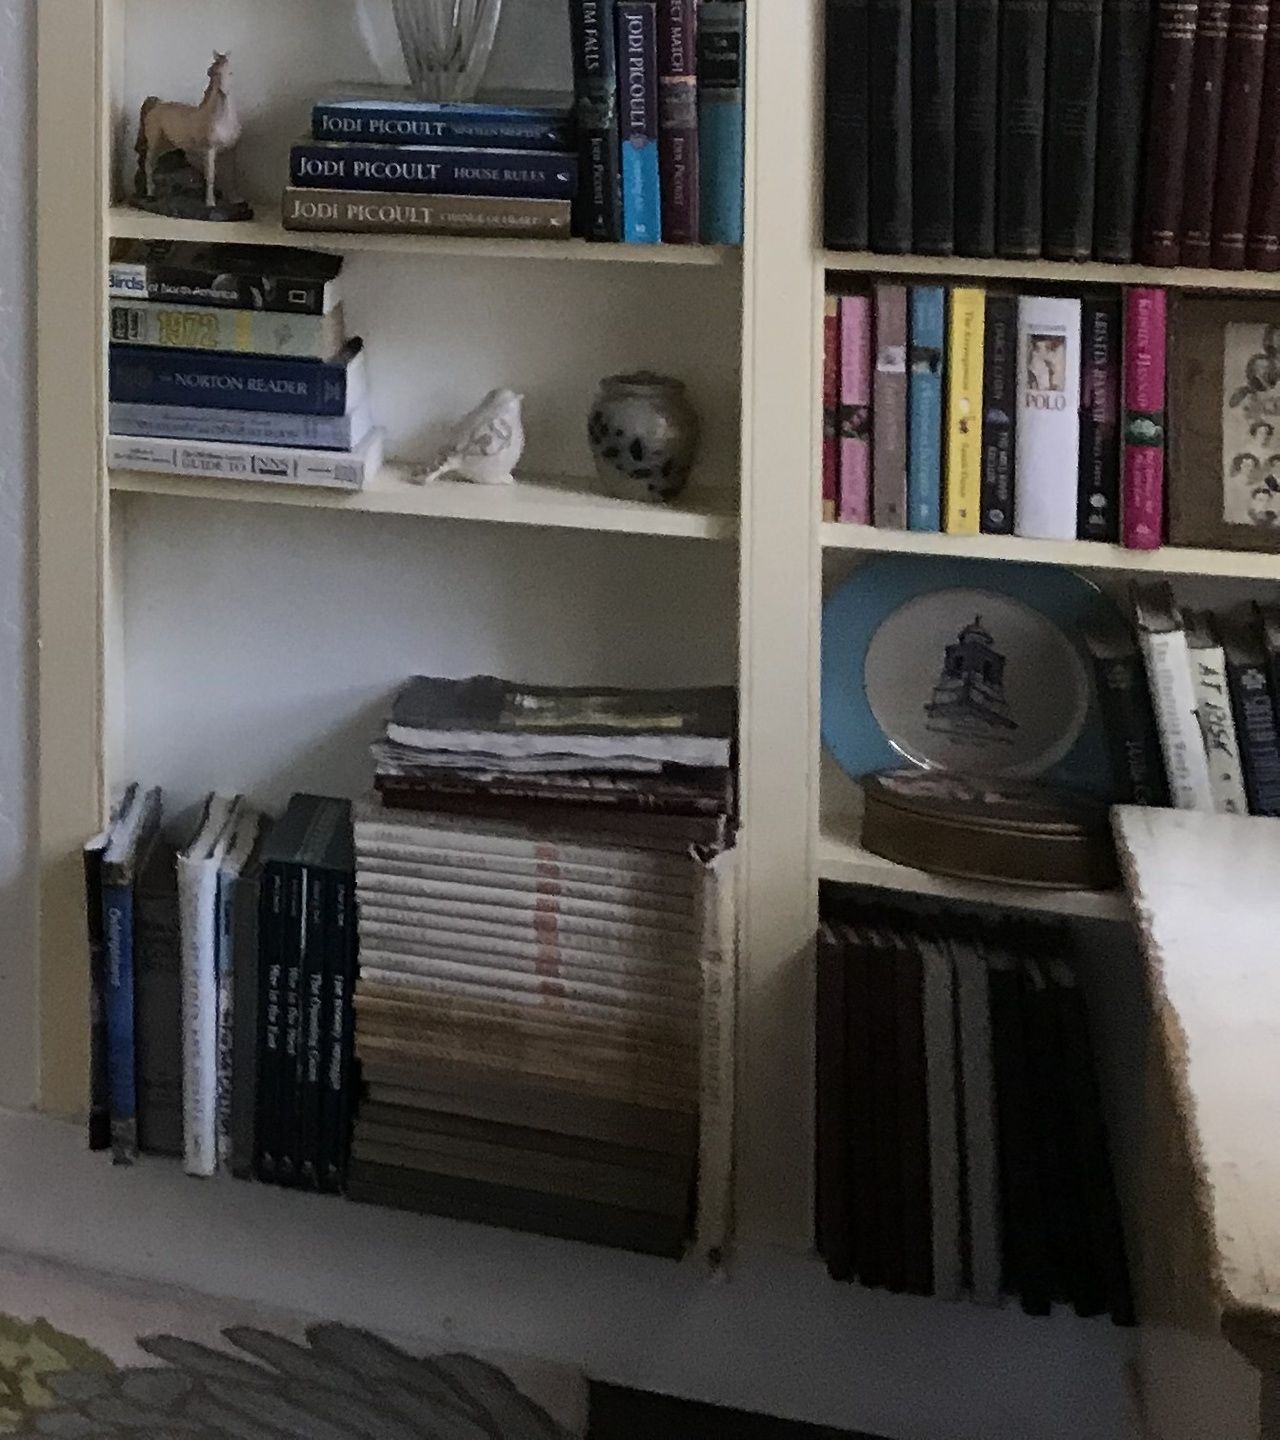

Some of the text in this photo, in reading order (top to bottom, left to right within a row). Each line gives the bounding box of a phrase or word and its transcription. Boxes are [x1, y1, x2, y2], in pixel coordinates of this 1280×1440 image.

[585, 28, 599, 70] FALLS
[671, 26, 684, 73] MATCH
[625, 14, 647, 130] JODI PICOULT
[321, 114, 363, 133] JODI
[369, 118, 447, 137] PICOULT
[297, 156, 545, 182] JODI PICOULT HOUSE RULES
[290, 199, 338, 220] JODI
[346, 203, 434, 224] PICOULT
[175, 372, 243, 391] NORTON
[247, 378, 308, 395] READER
[1025, 393, 1067, 411] POLO
